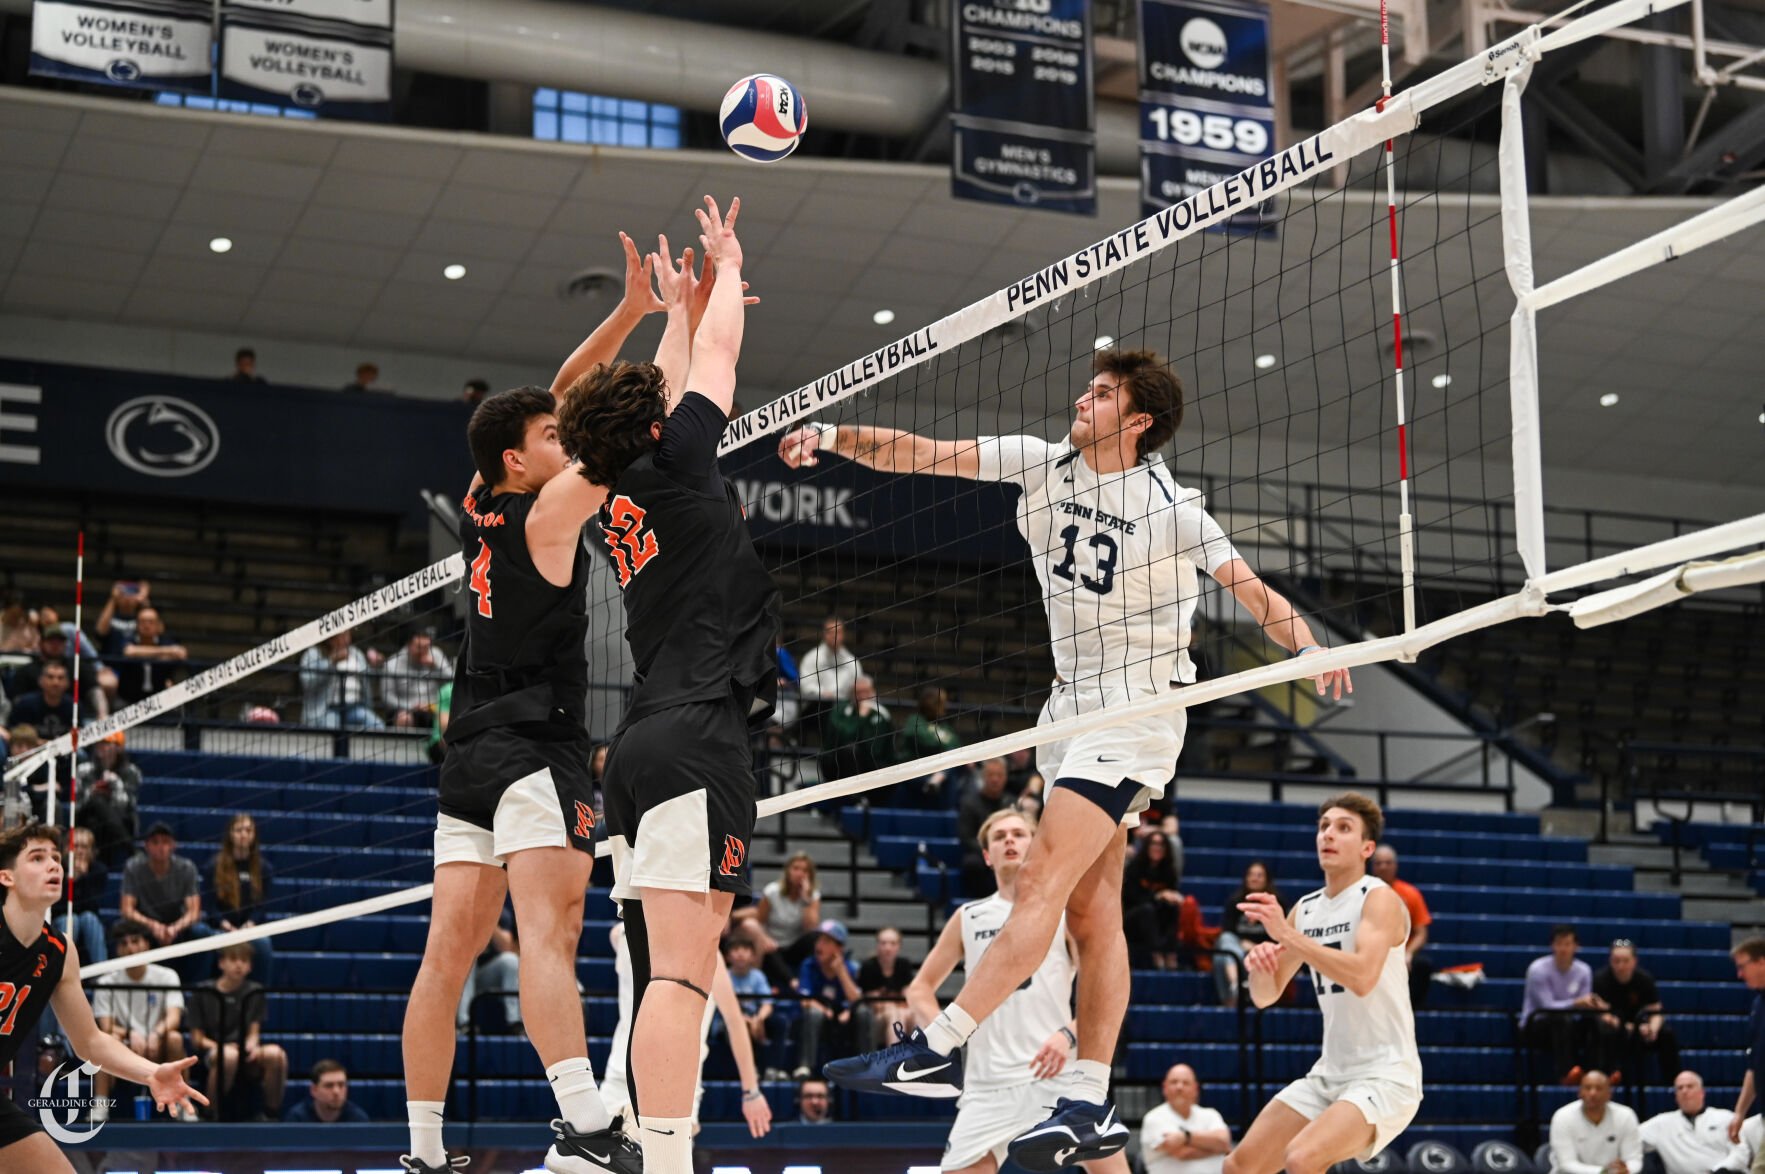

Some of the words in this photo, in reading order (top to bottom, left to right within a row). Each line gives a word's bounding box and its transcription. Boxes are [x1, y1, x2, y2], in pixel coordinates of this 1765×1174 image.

[62, 30, 187, 60] VOLLEYBALL
[78, 15, 173, 40] WOMEN'S
[264, 39, 354, 65] WOMEN'S
[1495, 42, 1520, 58] Senoh
[249, 55, 365, 86] VOLLEYBALL
[1151, 61, 1265, 97] CHAMPIONS
[778, 86, 789, 114] NCAA
[1148, 107, 1269, 155] 1959
[1006, 259, 1070, 312] PENN
[1075, 221, 1150, 278] STATE
[1156, 135, 1333, 240] VOLLEYBALL
[720, 414, 753, 450] ENN
[758, 387, 811, 431] STATE
[815, 327, 938, 402] VOLLEYBALL
[1057, 501, 1093, 520] PENN
[1094, 510, 1137, 536] STATE
[470, 536, 493, 619] 4
[1052, 524, 1118, 596] 13
[318, 609, 345, 636] PENN
[349, 592, 379, 622] STATE
[381, 560, 451, 604] VOLLEYBALL
[209, 660, 233, 687] STATE
[235, 636, 290, 675] VOLLEYBALL
